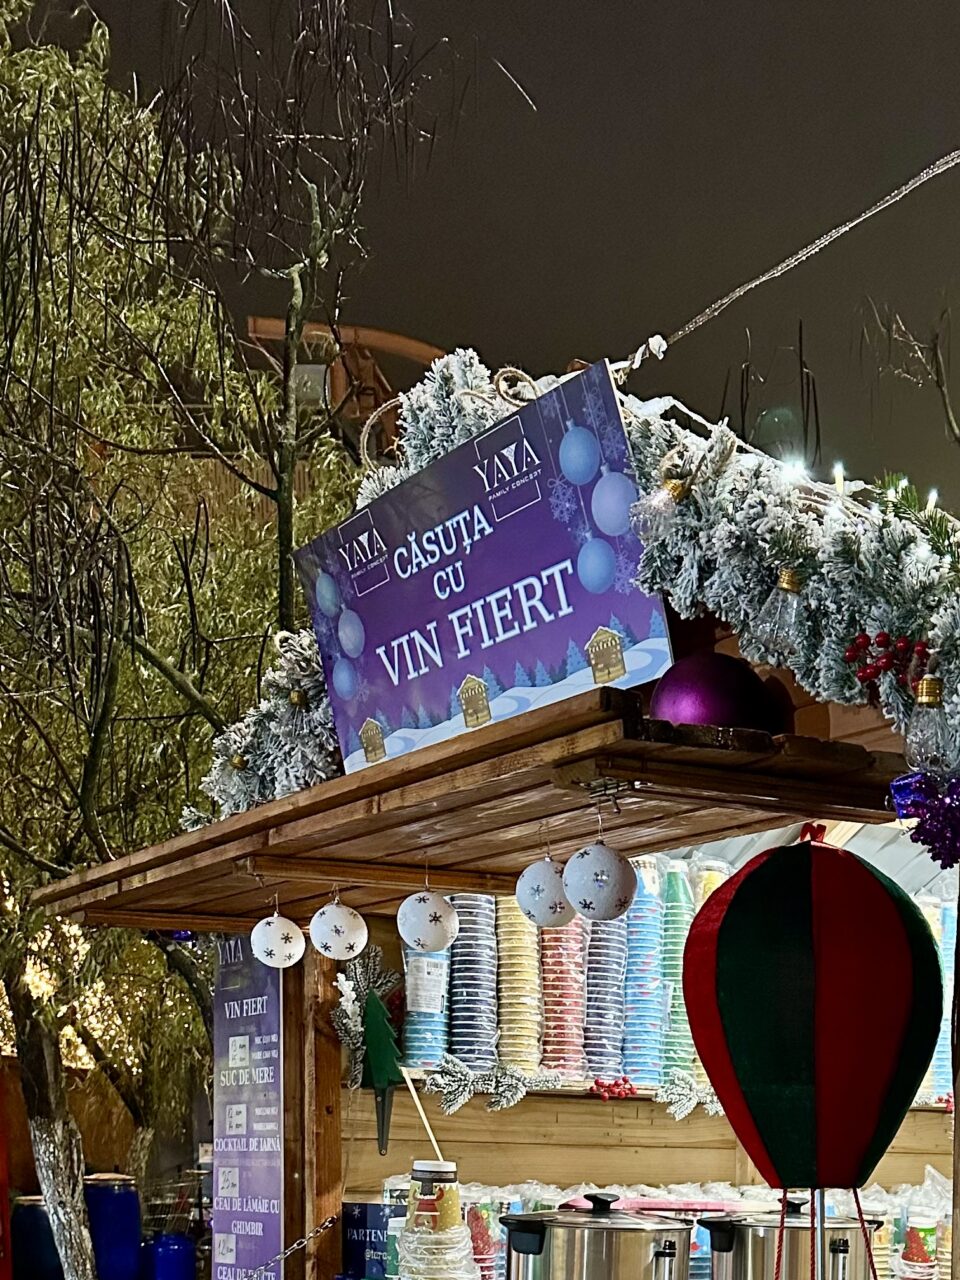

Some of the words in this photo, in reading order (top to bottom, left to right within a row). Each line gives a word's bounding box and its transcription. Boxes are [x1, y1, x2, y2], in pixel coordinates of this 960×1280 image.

[472, 437, 541, 493] YAYA
[488, 485, 511, 501] FAMILY
[511, 468, 541, 489] CONCEPT
[338, 527, 387, 571] YAYA
[393, 504, 494, 579] CĂSUȚA
[433, 560, 466, 600] CU
[376, 620, 444, 687] VIN
[448, 558, 574, 660] FIERT
[224, 1000, 241, 1019] VIN
[243, 996, 268, 1017] FIERT
[220, 1070, 237, 1086] SUC
[239, 1069, 250, 1085] DE
[251, 1066, 275, 1084] MERE
[214, 1137, 248, 1151] COCKTAIL
[249, 1137, 259, 1151] DE
[215, 1196, 231, 1211] CEAI
[232, 1198, 242, 1211] DE
[270, 1199, 280, 1214] CU
[231, 1220, 264, 1236] GHIMBIR
[217, 1266, 235, 1280] CEAI
